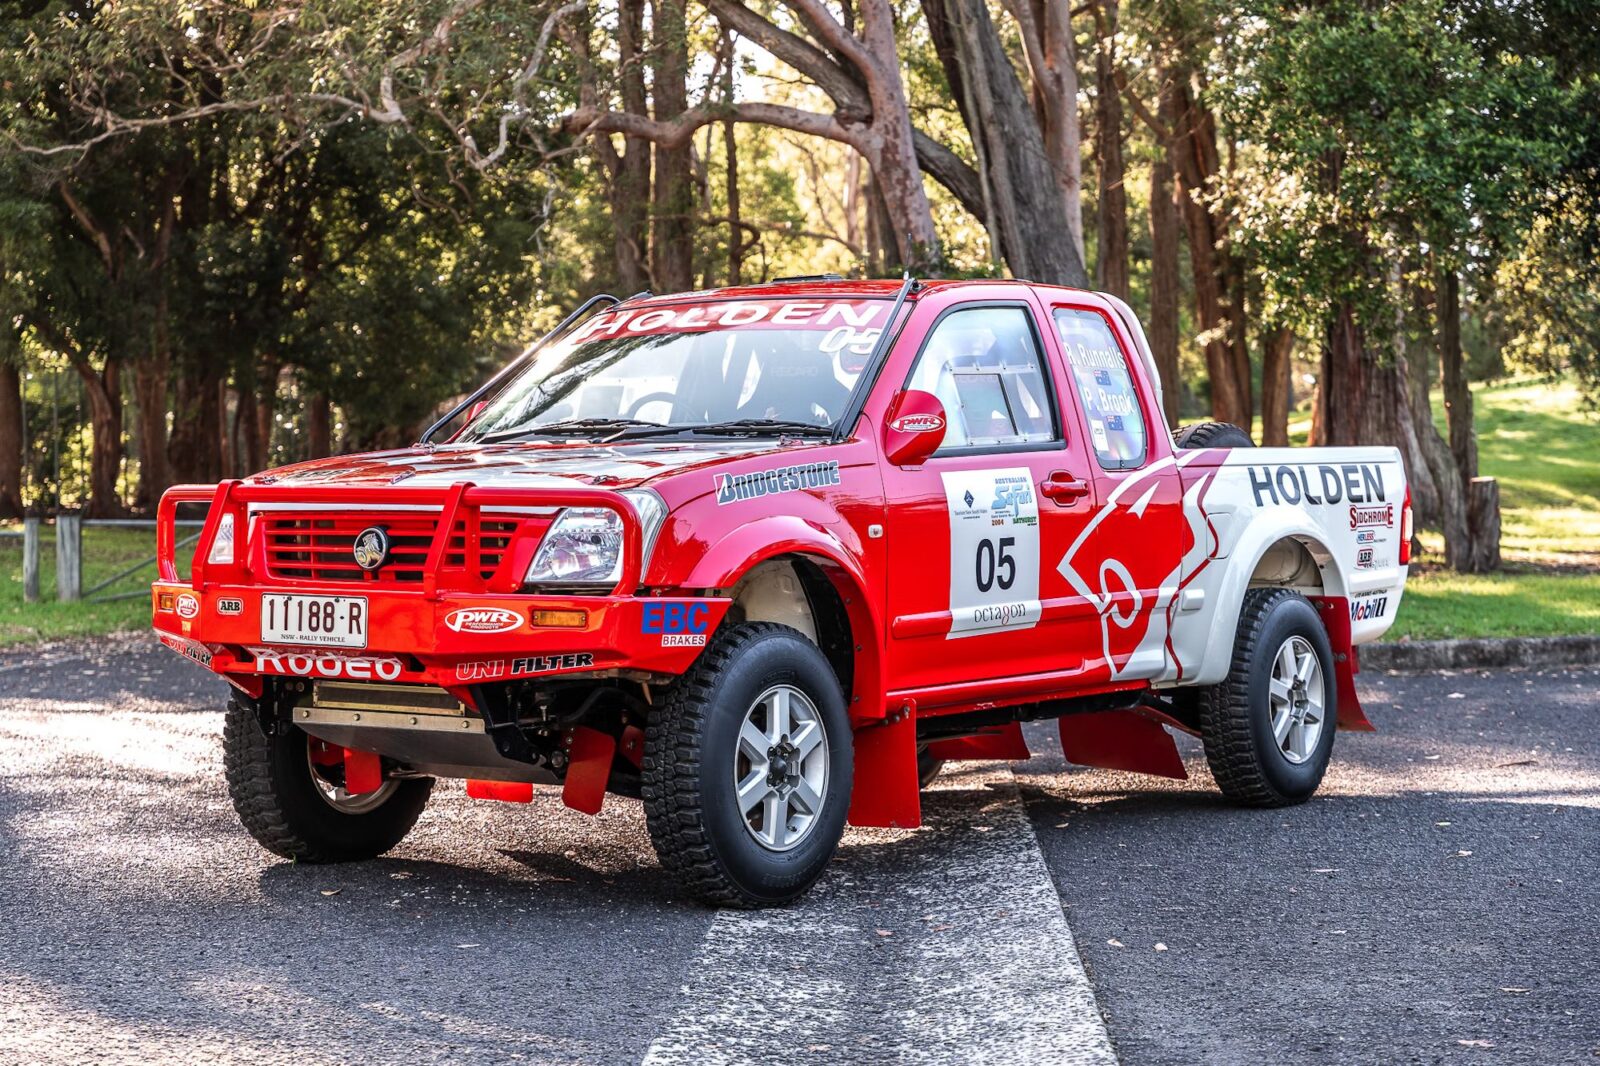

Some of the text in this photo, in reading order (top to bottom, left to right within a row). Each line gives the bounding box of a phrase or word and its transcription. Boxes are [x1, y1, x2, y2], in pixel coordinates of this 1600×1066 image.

[576, 302, 884, 339] HOLDEN
[819, 326, 884, 354] 05
[1077, 343, 1127, 370] Runnalls
[1098, 387, 1135, 414] Brock
[715, 460, 840, 504] BRIDGESTONE
[994, 476, 1027, 485] AUSTRALIAN
[1247, 464, 1386, 507] HOLDEN
[1350, 505, 1393, 528] SIDCHROME
[975, 536, 1016, 593] 05
[220, 601, 240, 611] ARB
[641, 602, 709, 634] EBC
[974, 603, 1026, 625] octagon
[455, 611, 510, 632] PWR
[662, 635, 705, 646] BRAKES
[456, 652, 594, 680] UNI FILTER
